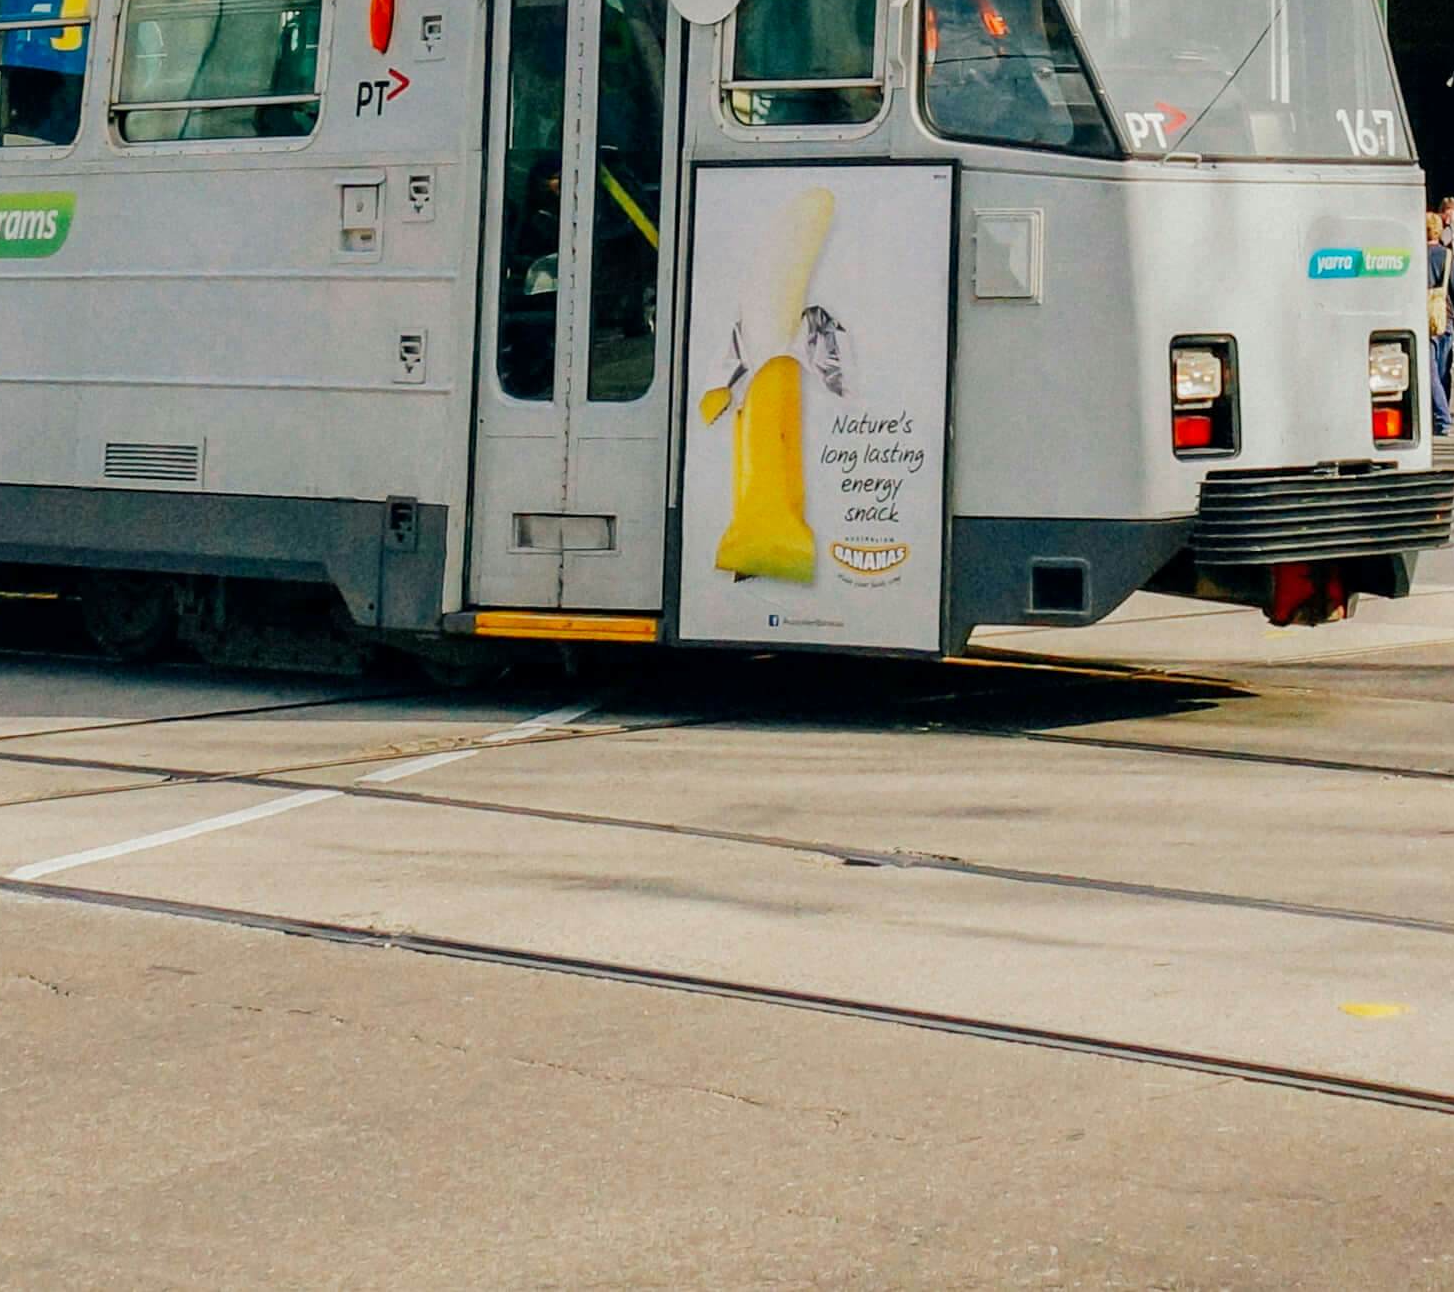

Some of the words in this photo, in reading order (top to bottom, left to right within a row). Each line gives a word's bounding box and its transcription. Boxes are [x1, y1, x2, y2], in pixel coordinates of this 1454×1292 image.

[356, 81, 390, 117] PT
[1336, 109, 1395, 157] 167
[1316, 255, 1353, 275] yarra
[1365, 252, 1404, 271] trams
[831, 410, 913, 434] Nature's
[820, 444, 858, 474] long
[863, 441, 925, 473] lasting
[841, 478, 904, 503] energy
[844, 502, 899, 523] snack
[833, 544, 906, 571] BANANAS
